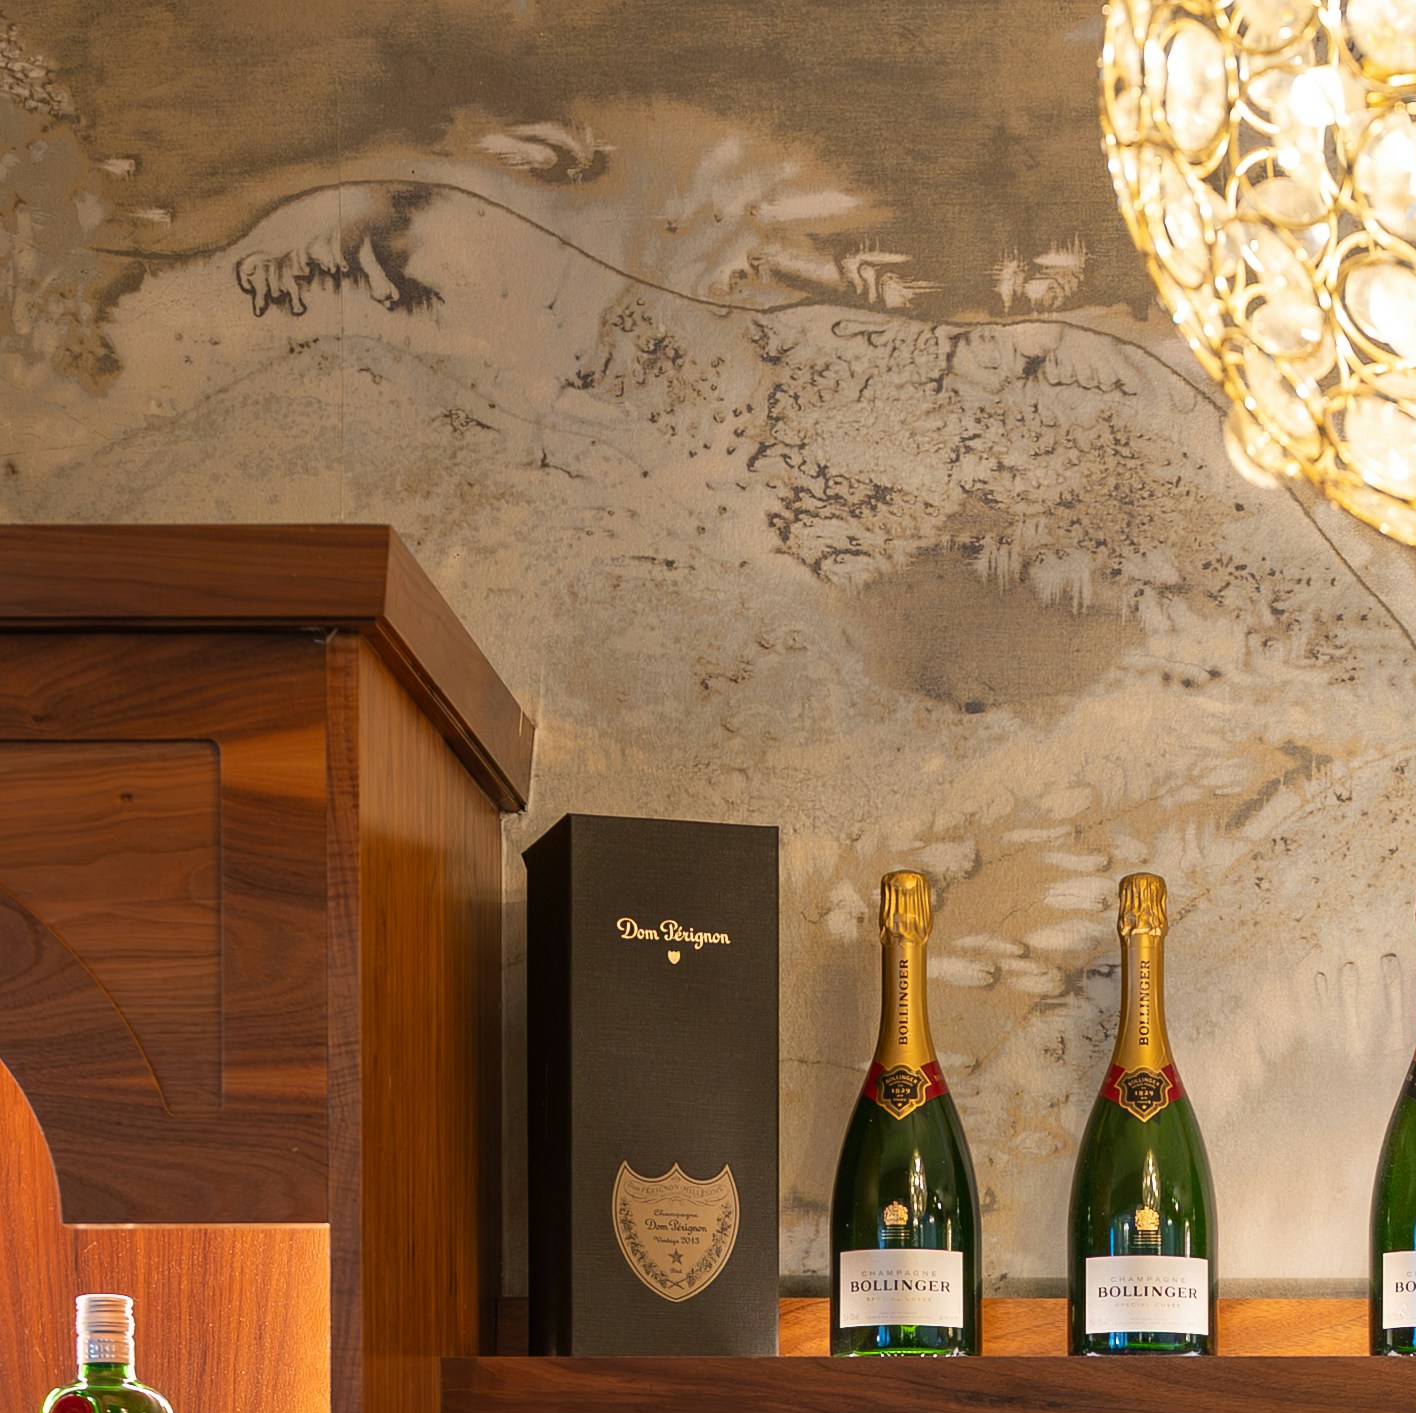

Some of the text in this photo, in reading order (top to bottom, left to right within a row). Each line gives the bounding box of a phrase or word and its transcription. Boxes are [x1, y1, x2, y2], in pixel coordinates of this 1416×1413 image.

[617, 917, 731, 949] Dom Pérignon
[899, 959, 909, 1046] BOLLINGER
[1139, 960, 1150, 1046] BOLLINGER
[861, 1269, 937, 1277] CHAMPAGNE
[850, 1280, 950, 1293] BOLLINGER
[1110, 1276, 1186, 1284] CHAMPAGNE
[1098, 1286, 1198, 1299] BOLLINGER
